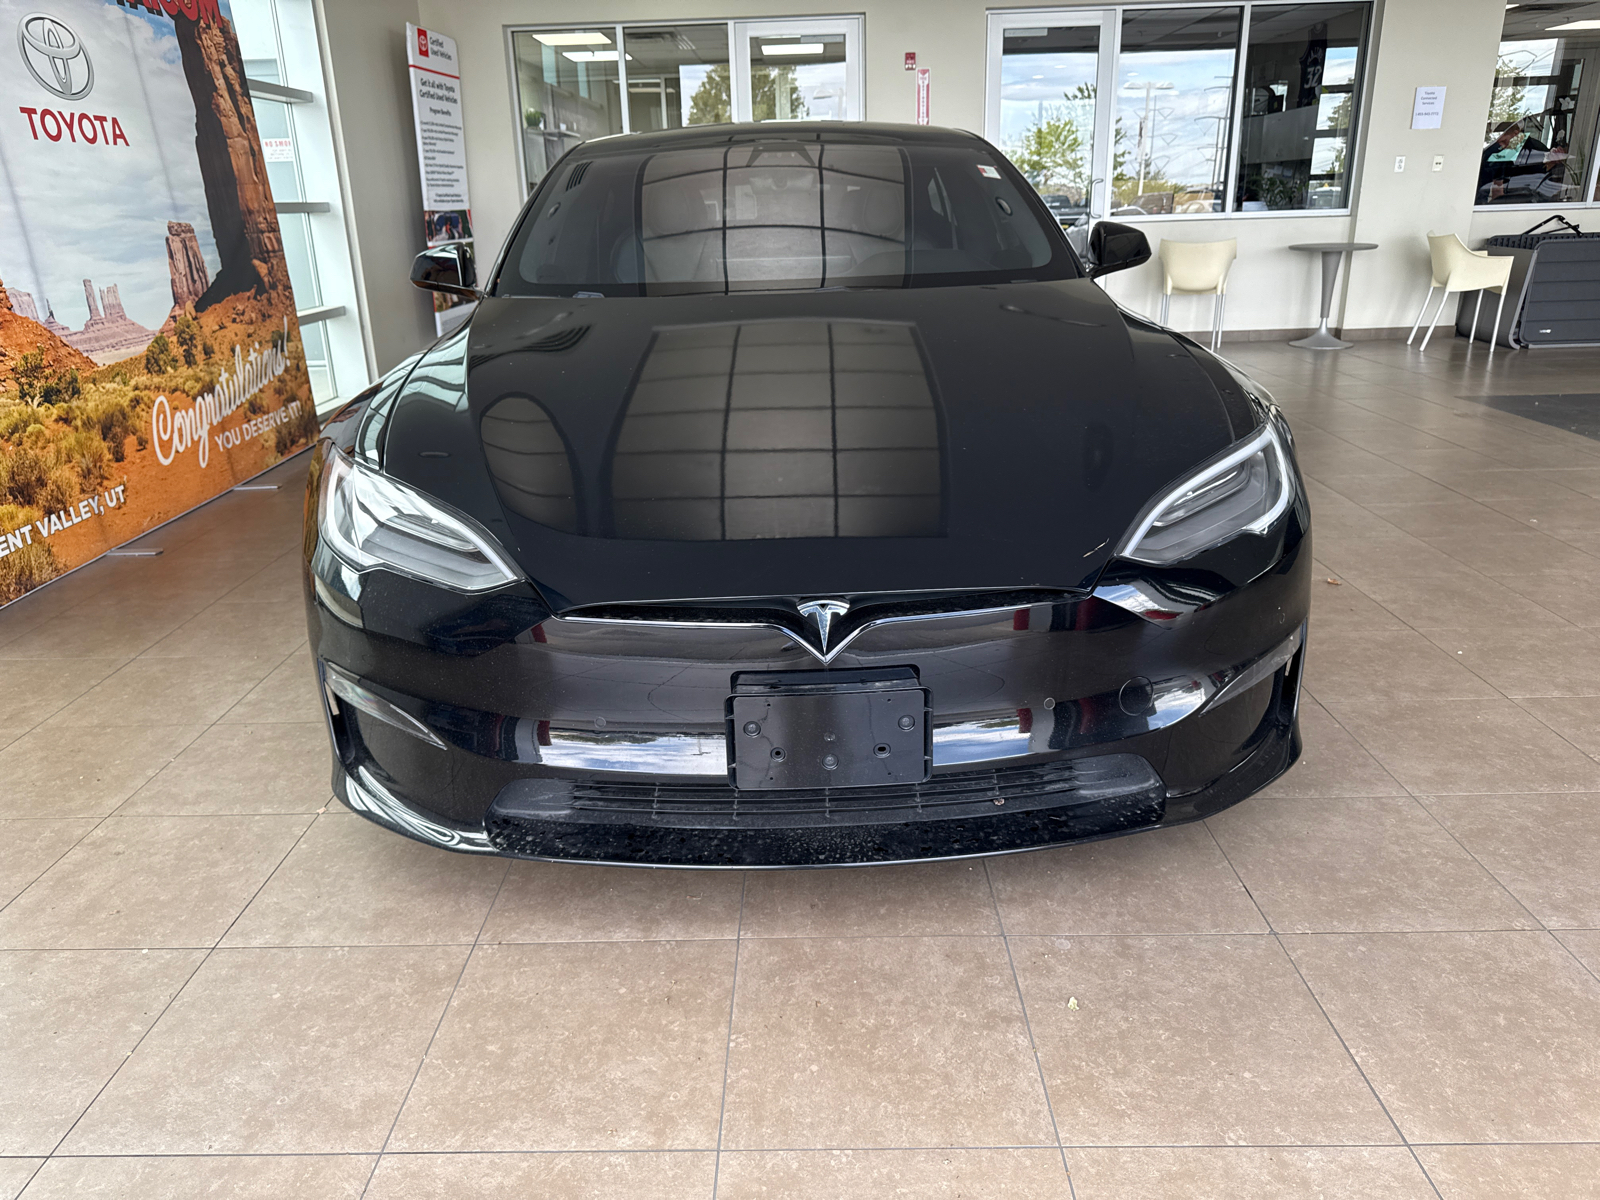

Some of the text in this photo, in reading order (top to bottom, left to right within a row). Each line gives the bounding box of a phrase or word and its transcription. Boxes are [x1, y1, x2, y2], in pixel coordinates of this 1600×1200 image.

[1304, 66, 1322, 89] 32
[19, 106, 130, 147] TOYOTA
[152, 315, 291, 469] Congratulations!
[214, 400, 303, 452] YOU DESERVE IT!
[35, 495, 105, 538] VALLEY,
[104, 485, 125, 508] UT
